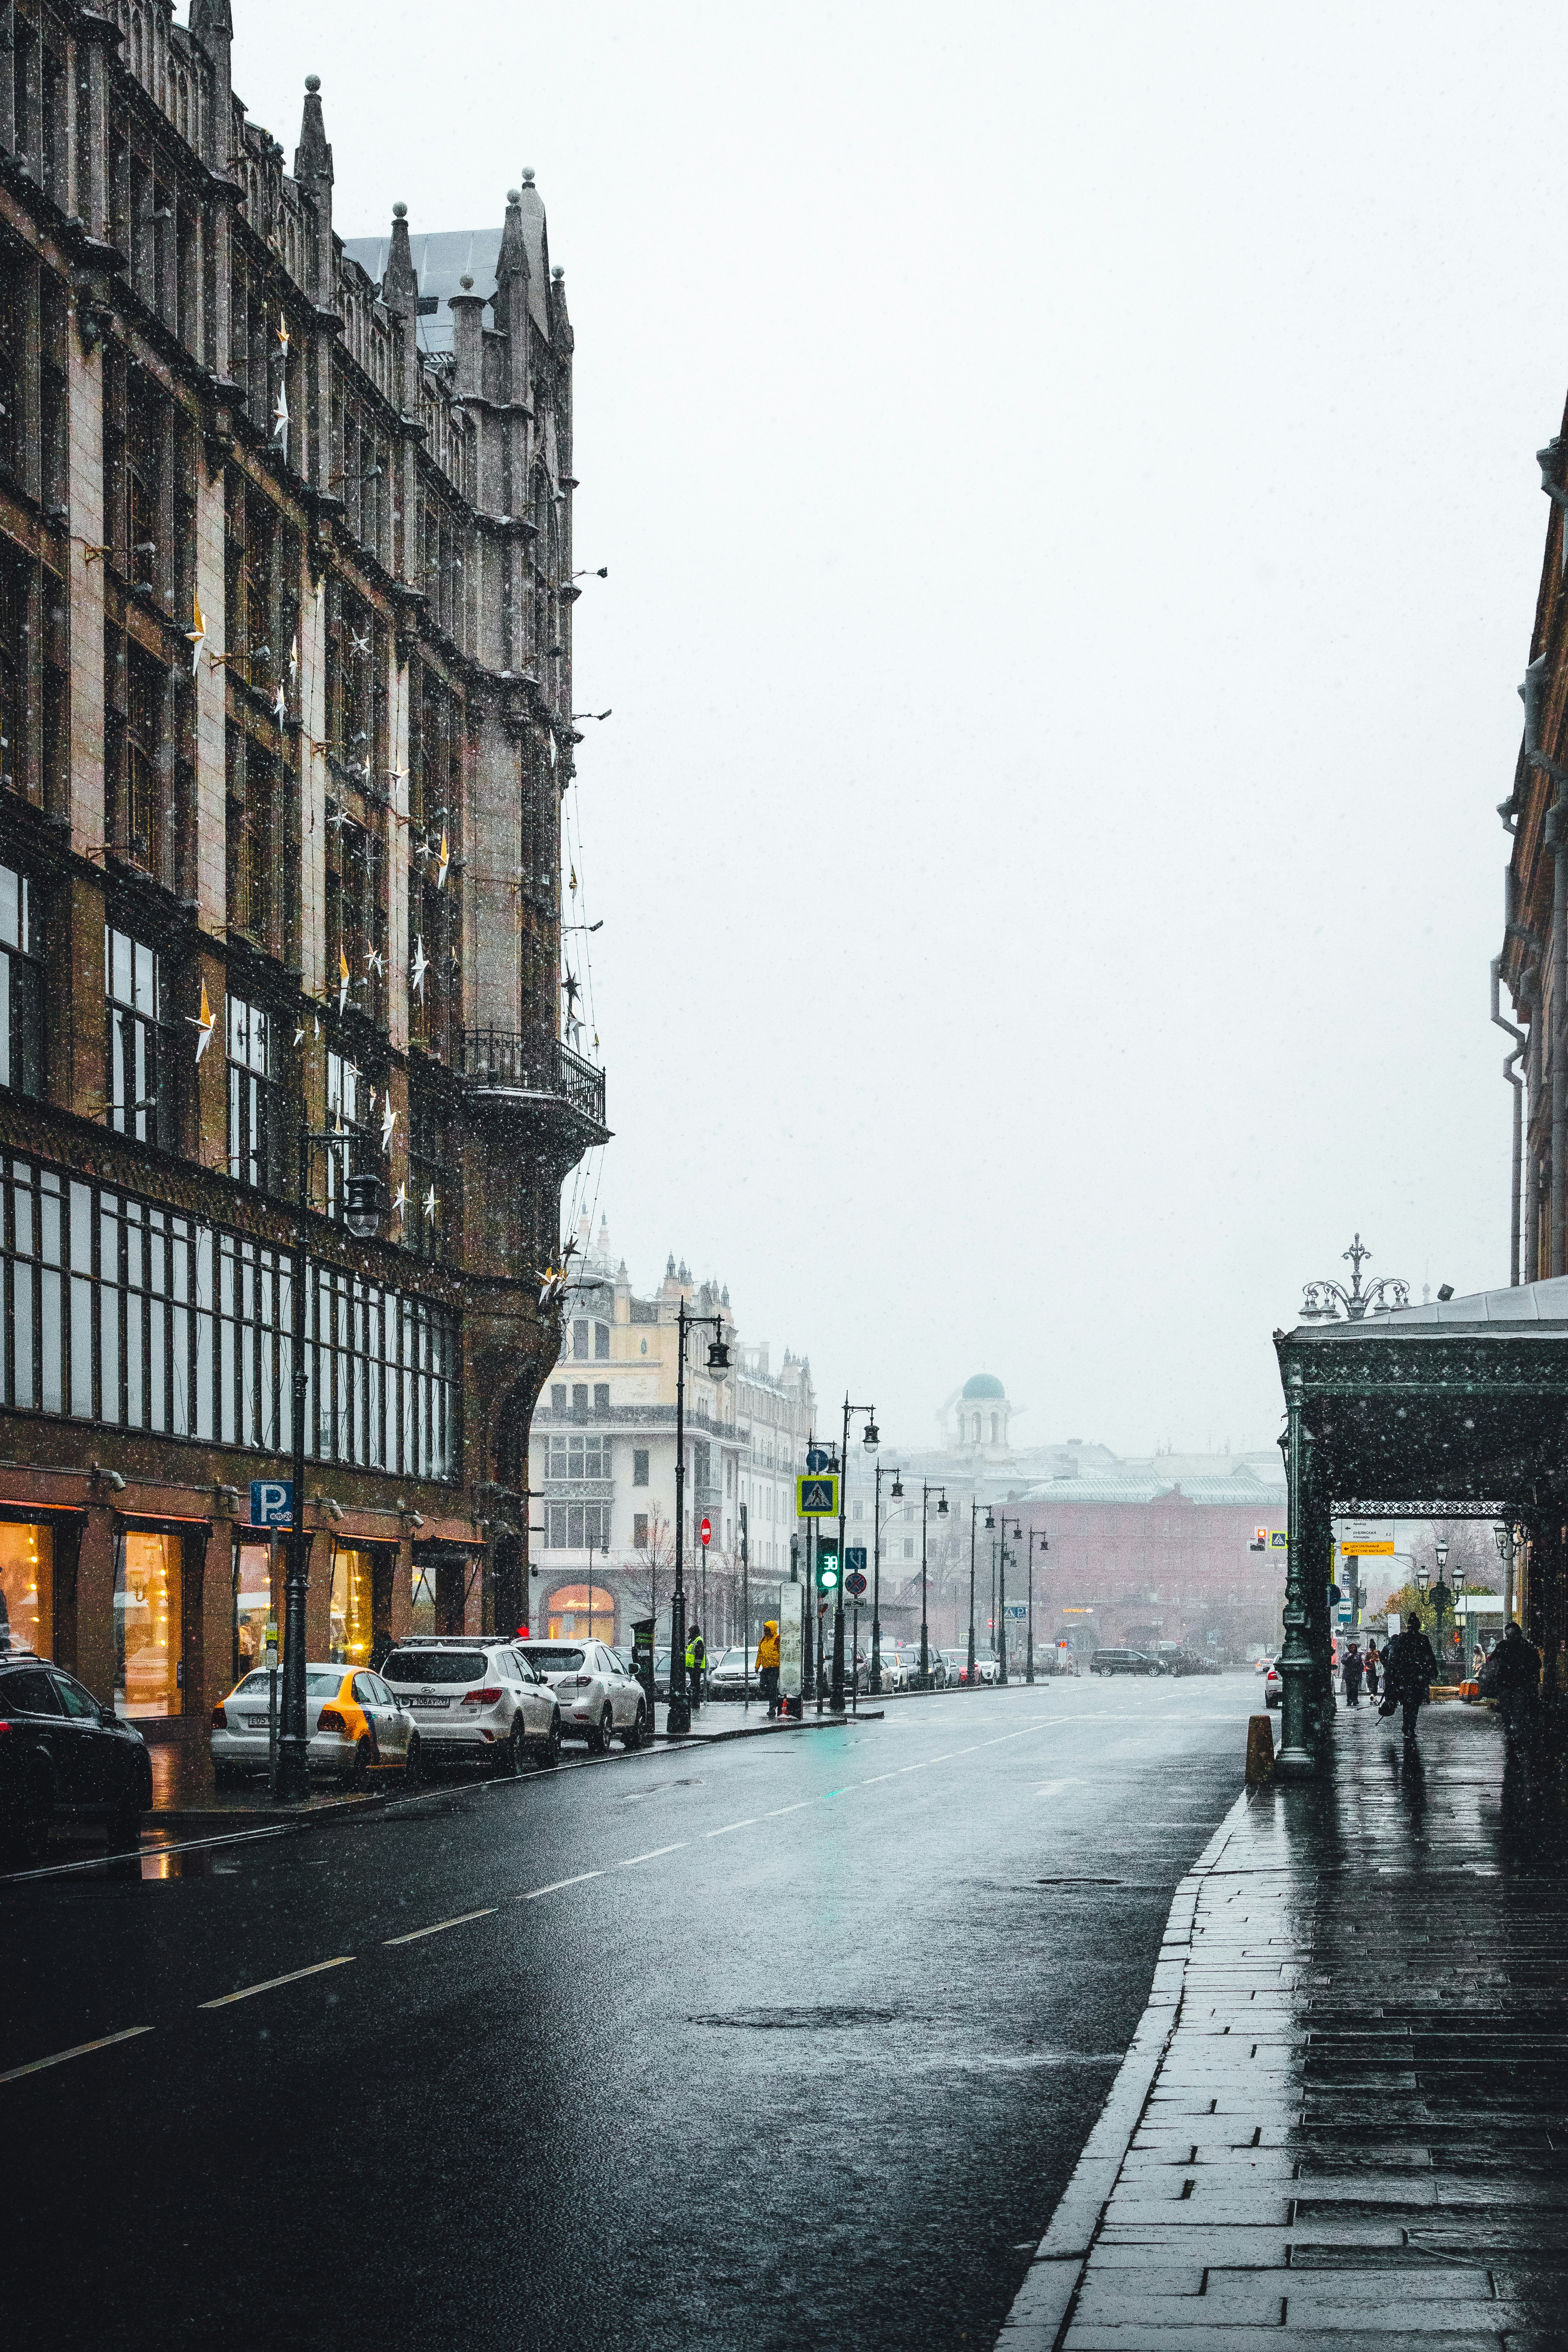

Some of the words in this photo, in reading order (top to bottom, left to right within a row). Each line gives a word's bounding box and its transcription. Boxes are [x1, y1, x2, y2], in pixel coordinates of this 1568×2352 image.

[261, 1484, 286, 1522] P
[824, 1556, 837, 1570] 38
[1017, 1608, 1024, 1617] P
